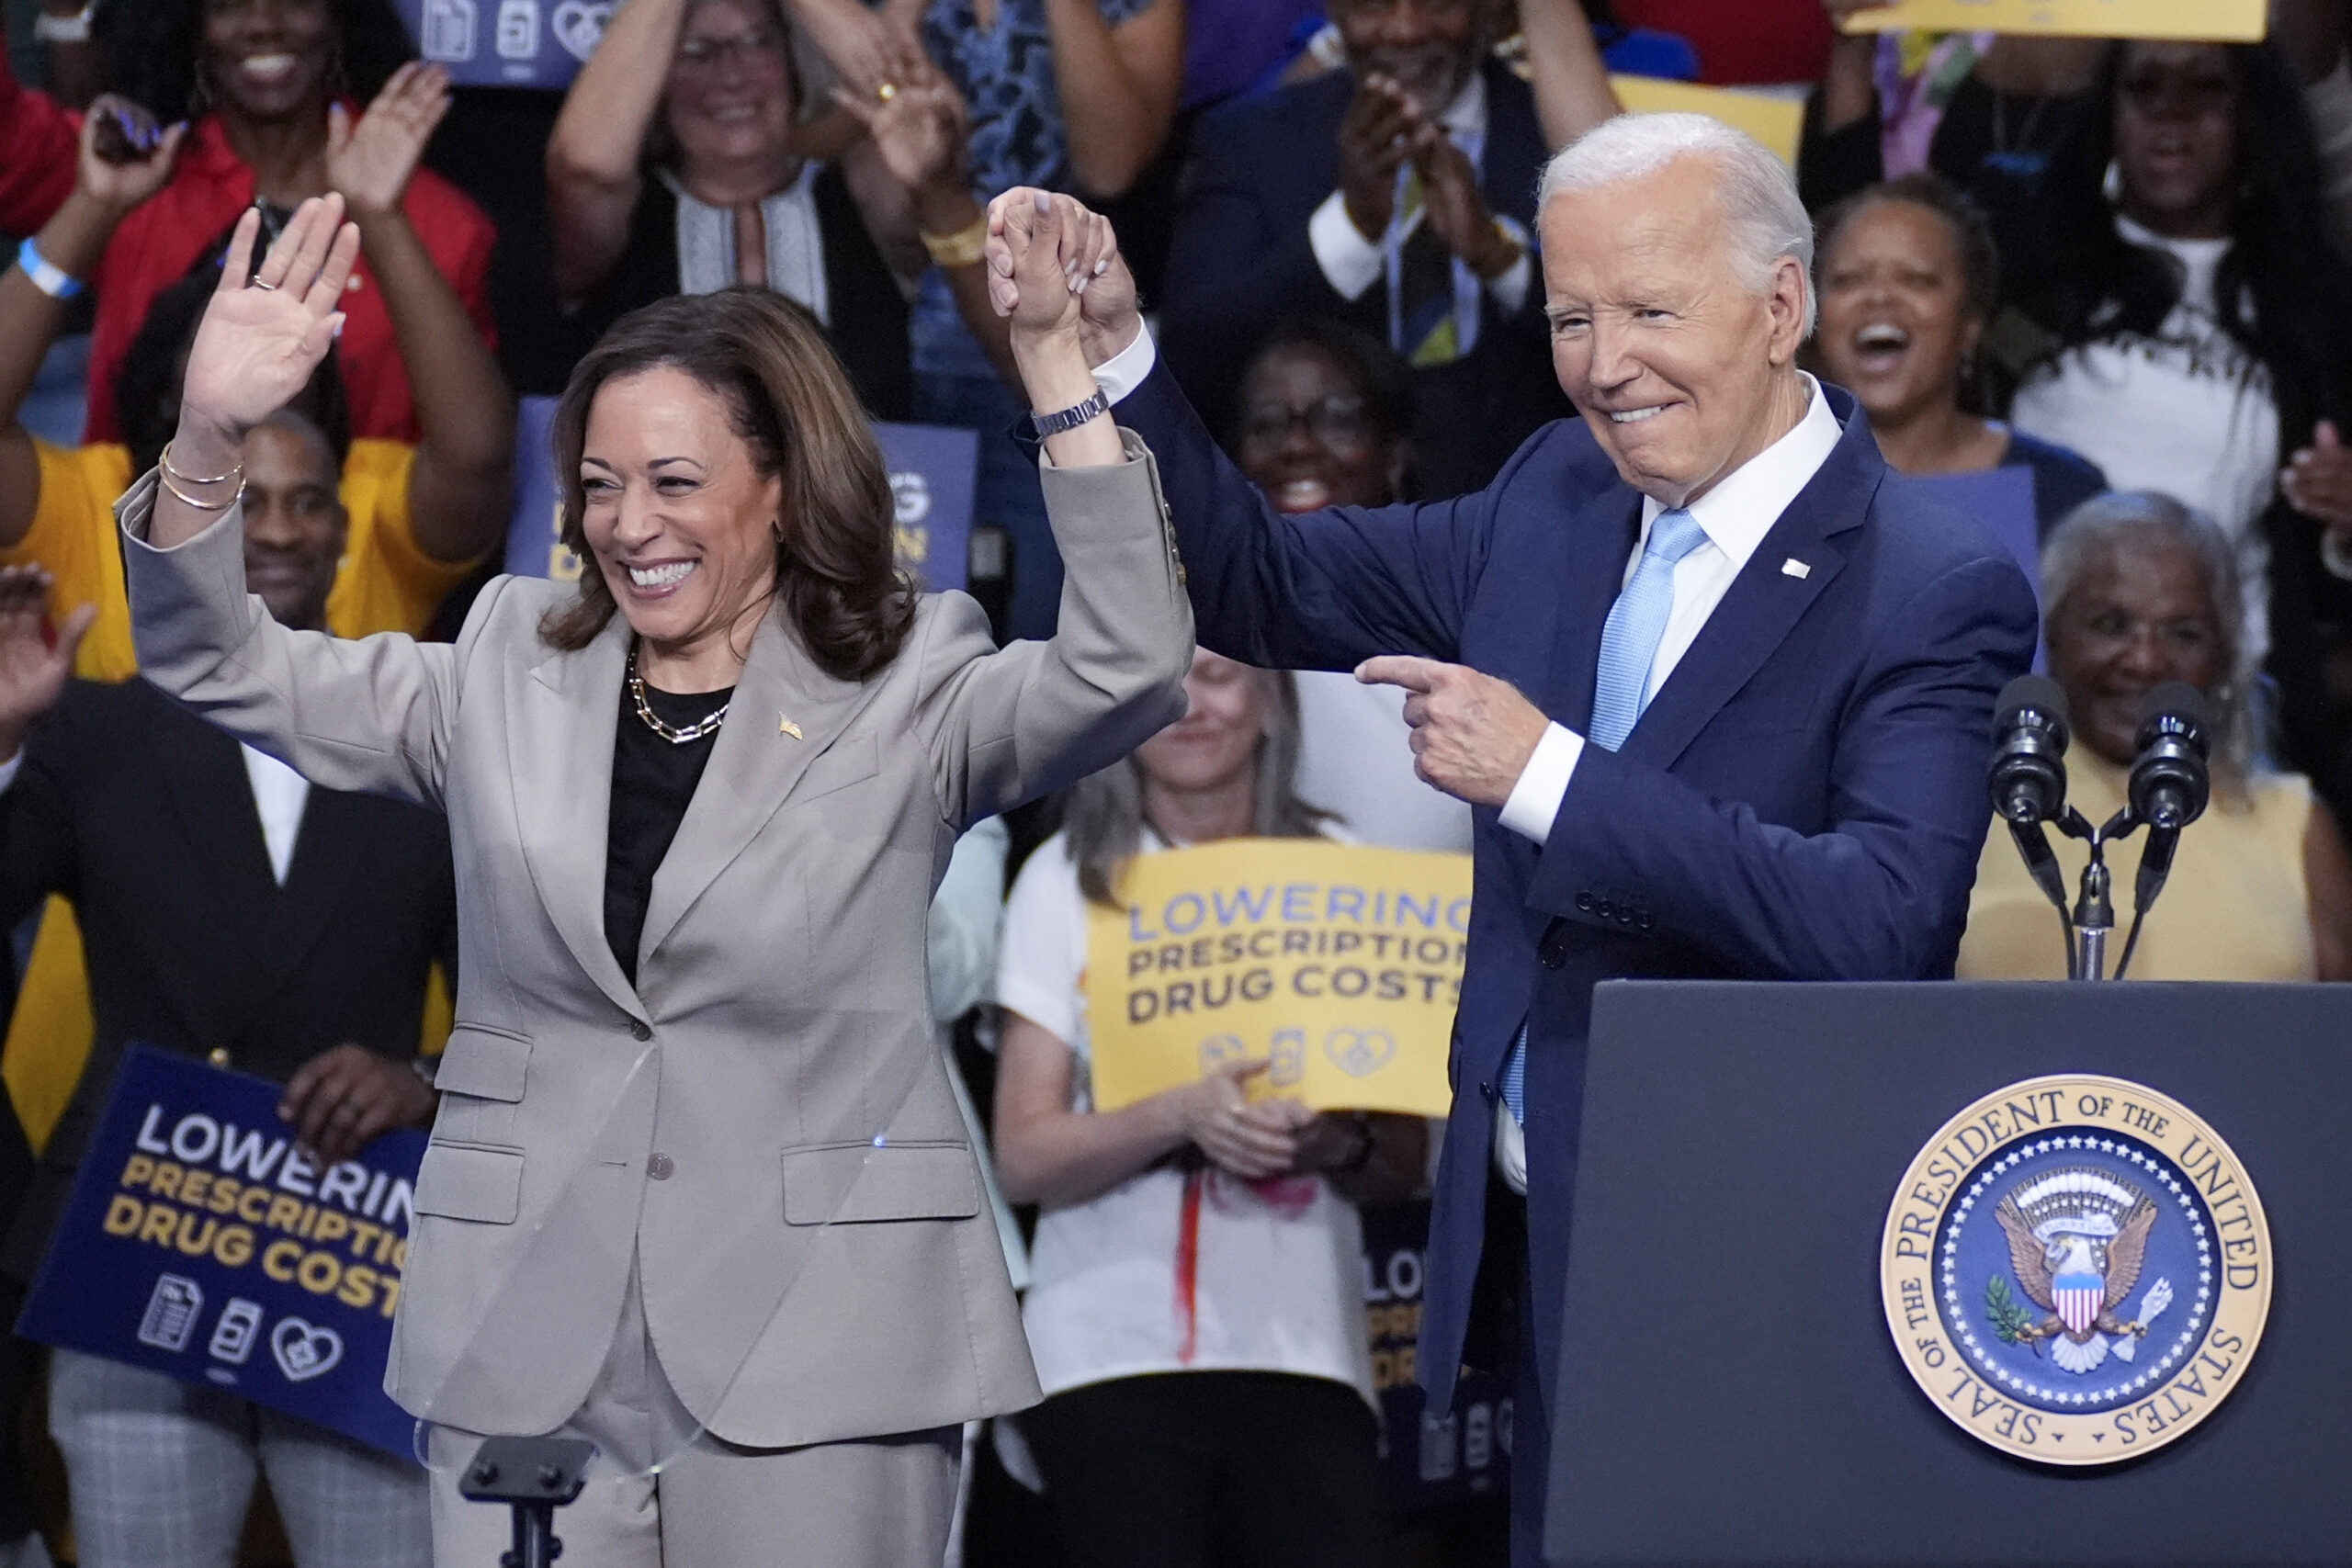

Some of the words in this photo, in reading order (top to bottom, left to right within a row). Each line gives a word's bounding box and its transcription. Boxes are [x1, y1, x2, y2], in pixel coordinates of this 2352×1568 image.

[1128, 967, 1274, 1025] DRUG
[2078, 1093, 2114, 1119] OF
[2122, 1101, 2170, 1140] THE
[136, 1103, 413, 1224] LOWERIN
[1896, 1089, 2066, 1262] PRESIDENT
[2178, 1134, 2259, 1291] UNITED
[103, 1194, 256, 1269] DRUG
[262, 1239, 401, 1319] COST
[1900, 1277, 1929, 1330] THE
[1917, 1337, 1946, 1370] OF
[2113, 1327, 2243, 1446] STATES
[1946, 1365, 2043, 1446] SEAL
